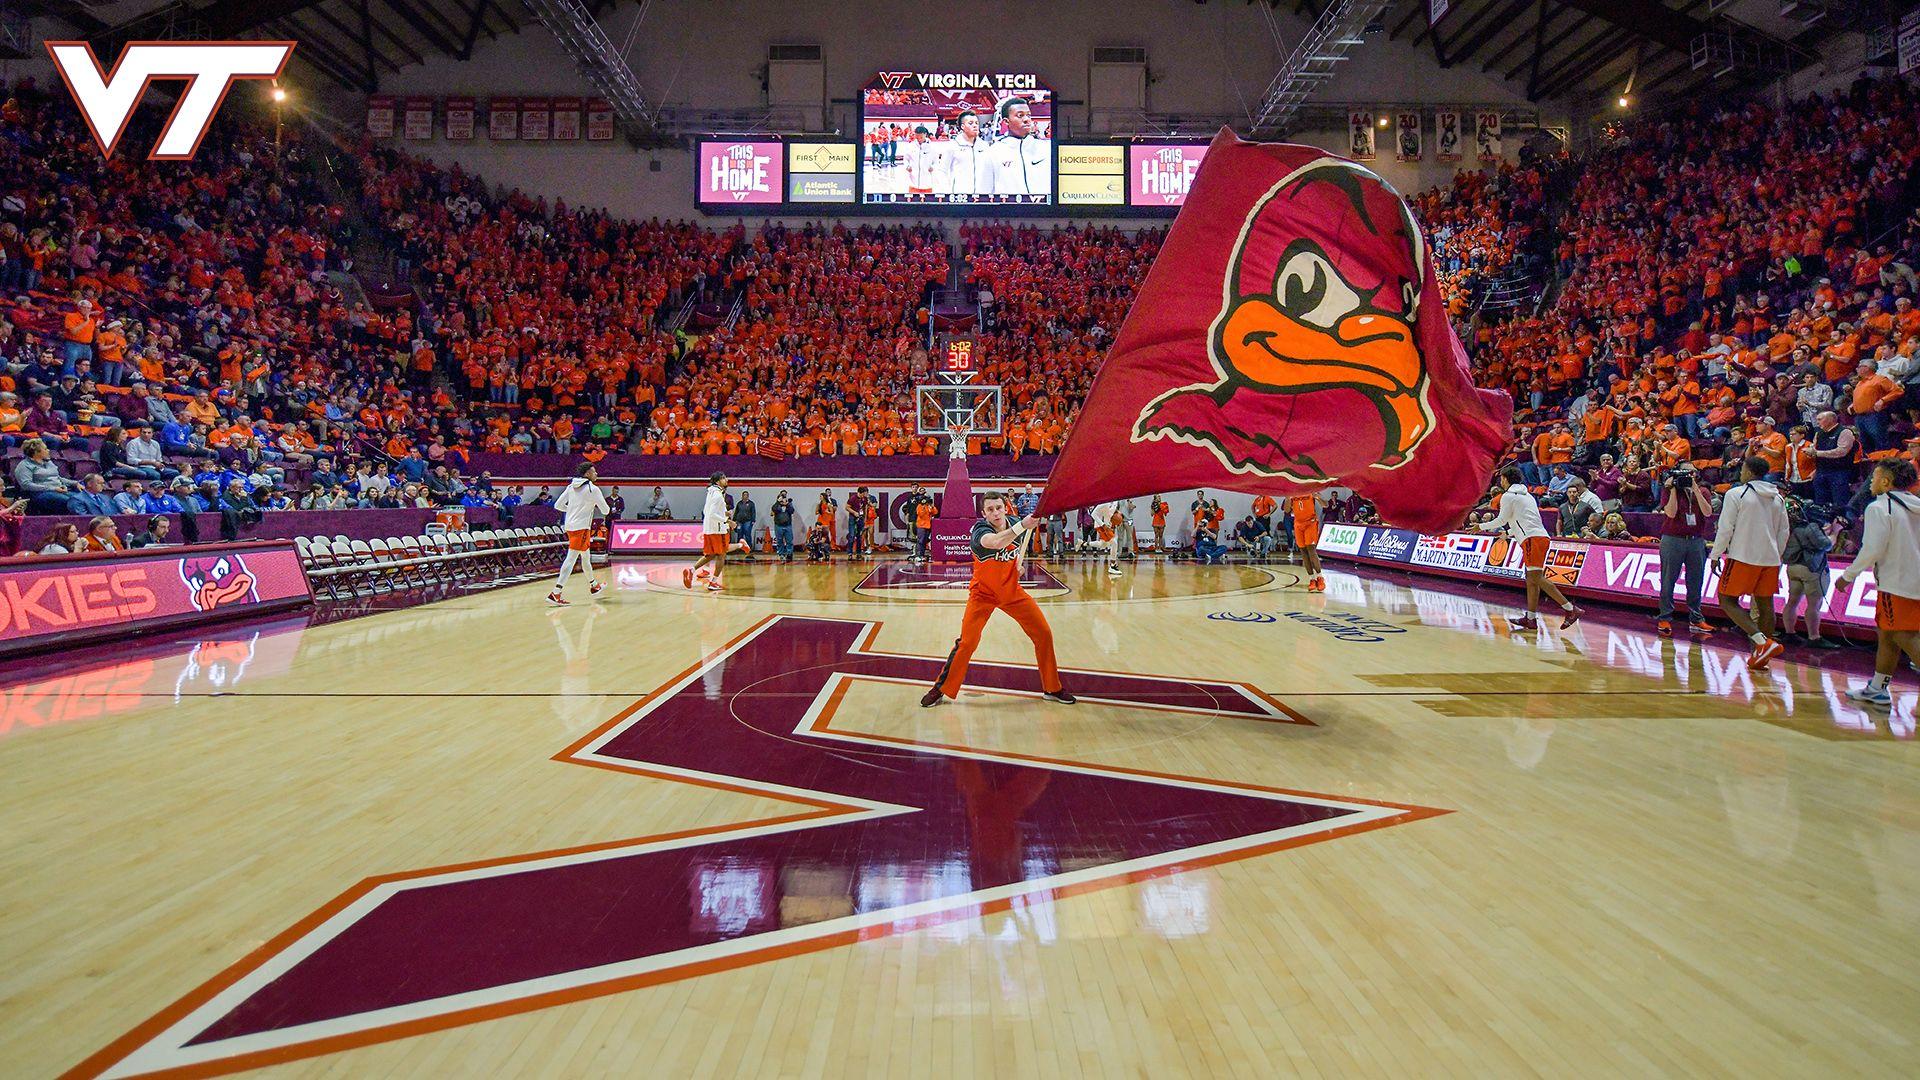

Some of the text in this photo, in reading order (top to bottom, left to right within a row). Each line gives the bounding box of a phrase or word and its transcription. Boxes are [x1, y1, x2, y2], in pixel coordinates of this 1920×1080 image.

[879, 72, 1036, 88] VT VIRGINIA TECH
[1399, 114, 1418, 129] 30
[726, 145, 753, 160] THIS
[1154, 148, 1183, 163] THIS
[737, 160, 746, 169] IS
[1167, 163, 1175, 172] IS
[711, 155, 772, 192] HOME
[1141, 158, 1202, 194] HOME
[804, 181, 838, 189] Atlantic
[732, 192, 750, 201] VT
[1162, 195, 1181, 203] VT
[951, 342, 971, 351] 6:02
[949, 352, 969, 369] 30
[617, 529, 650, 544] VT
[648, 531, 692, 543] LET'S
[1413, 549, 1449, 564] MARTIN
[1448, 552, 1482, 570] TRAVEL
[0, 568, 157, 634] KIES
